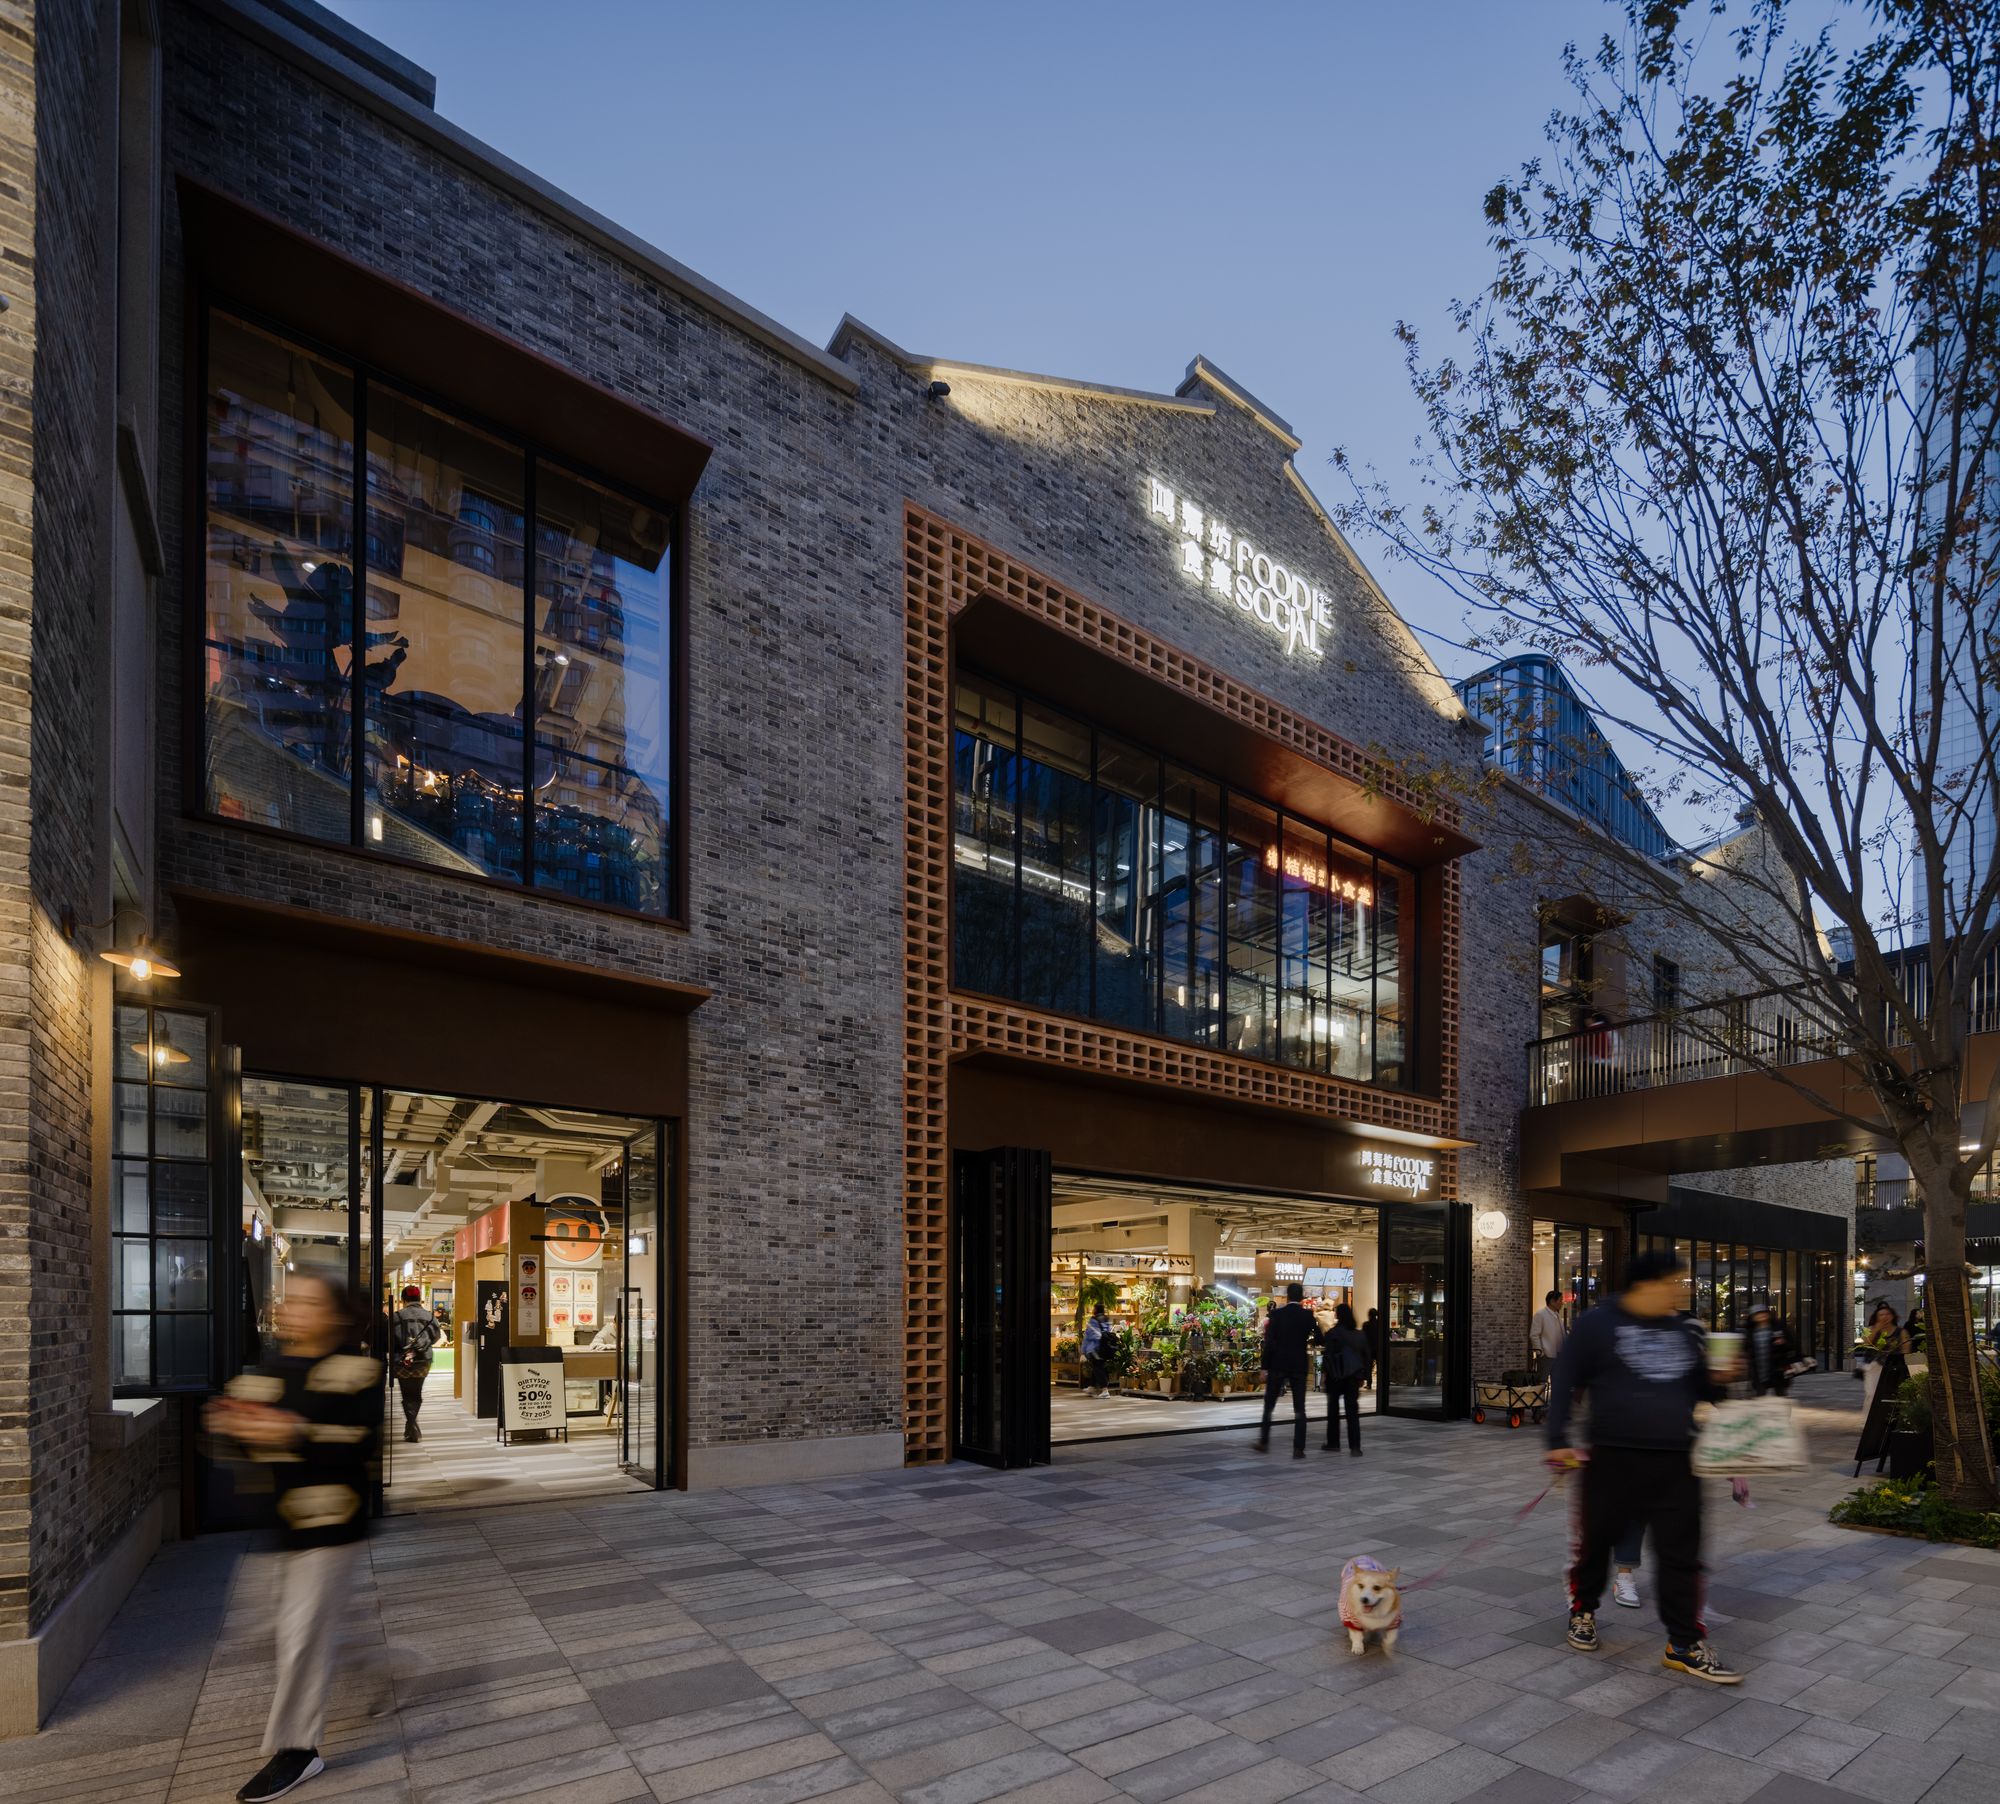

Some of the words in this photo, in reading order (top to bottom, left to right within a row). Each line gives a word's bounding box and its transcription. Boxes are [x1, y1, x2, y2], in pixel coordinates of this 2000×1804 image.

[1180, 540, 1232, 599] 食集
[1236, 541, 1334, 629] FOODIE
[1235, 574, 1324, 656] SOCIAL
[1371, 1168, 1393, 1186] 食集
[1393, 1156, 1434, 1177] FOODIE
[1392, 1171, 1430, 1198] SOCIAL
[518, 1390, 552, 1402] 50%
[534, 1410, 550, 1418] 2020
